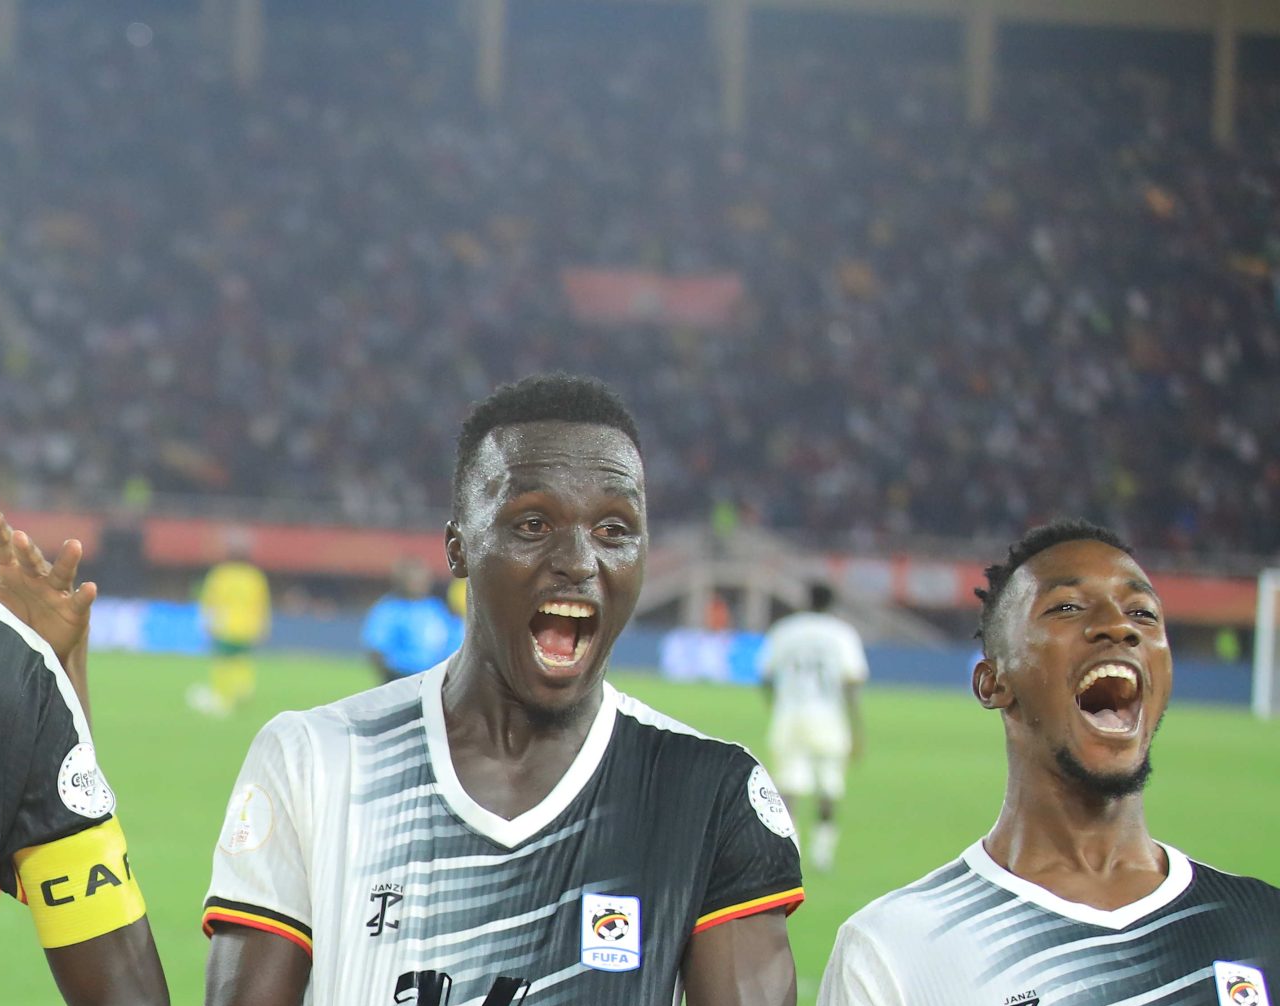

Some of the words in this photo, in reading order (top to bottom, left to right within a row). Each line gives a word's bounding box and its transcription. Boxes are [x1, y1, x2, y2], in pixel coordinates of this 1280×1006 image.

[371, 882, 404, 893] JANZI
[592, 952, 629, 964] FUFA
[1004, 989, 1037, 1005] JANZI
